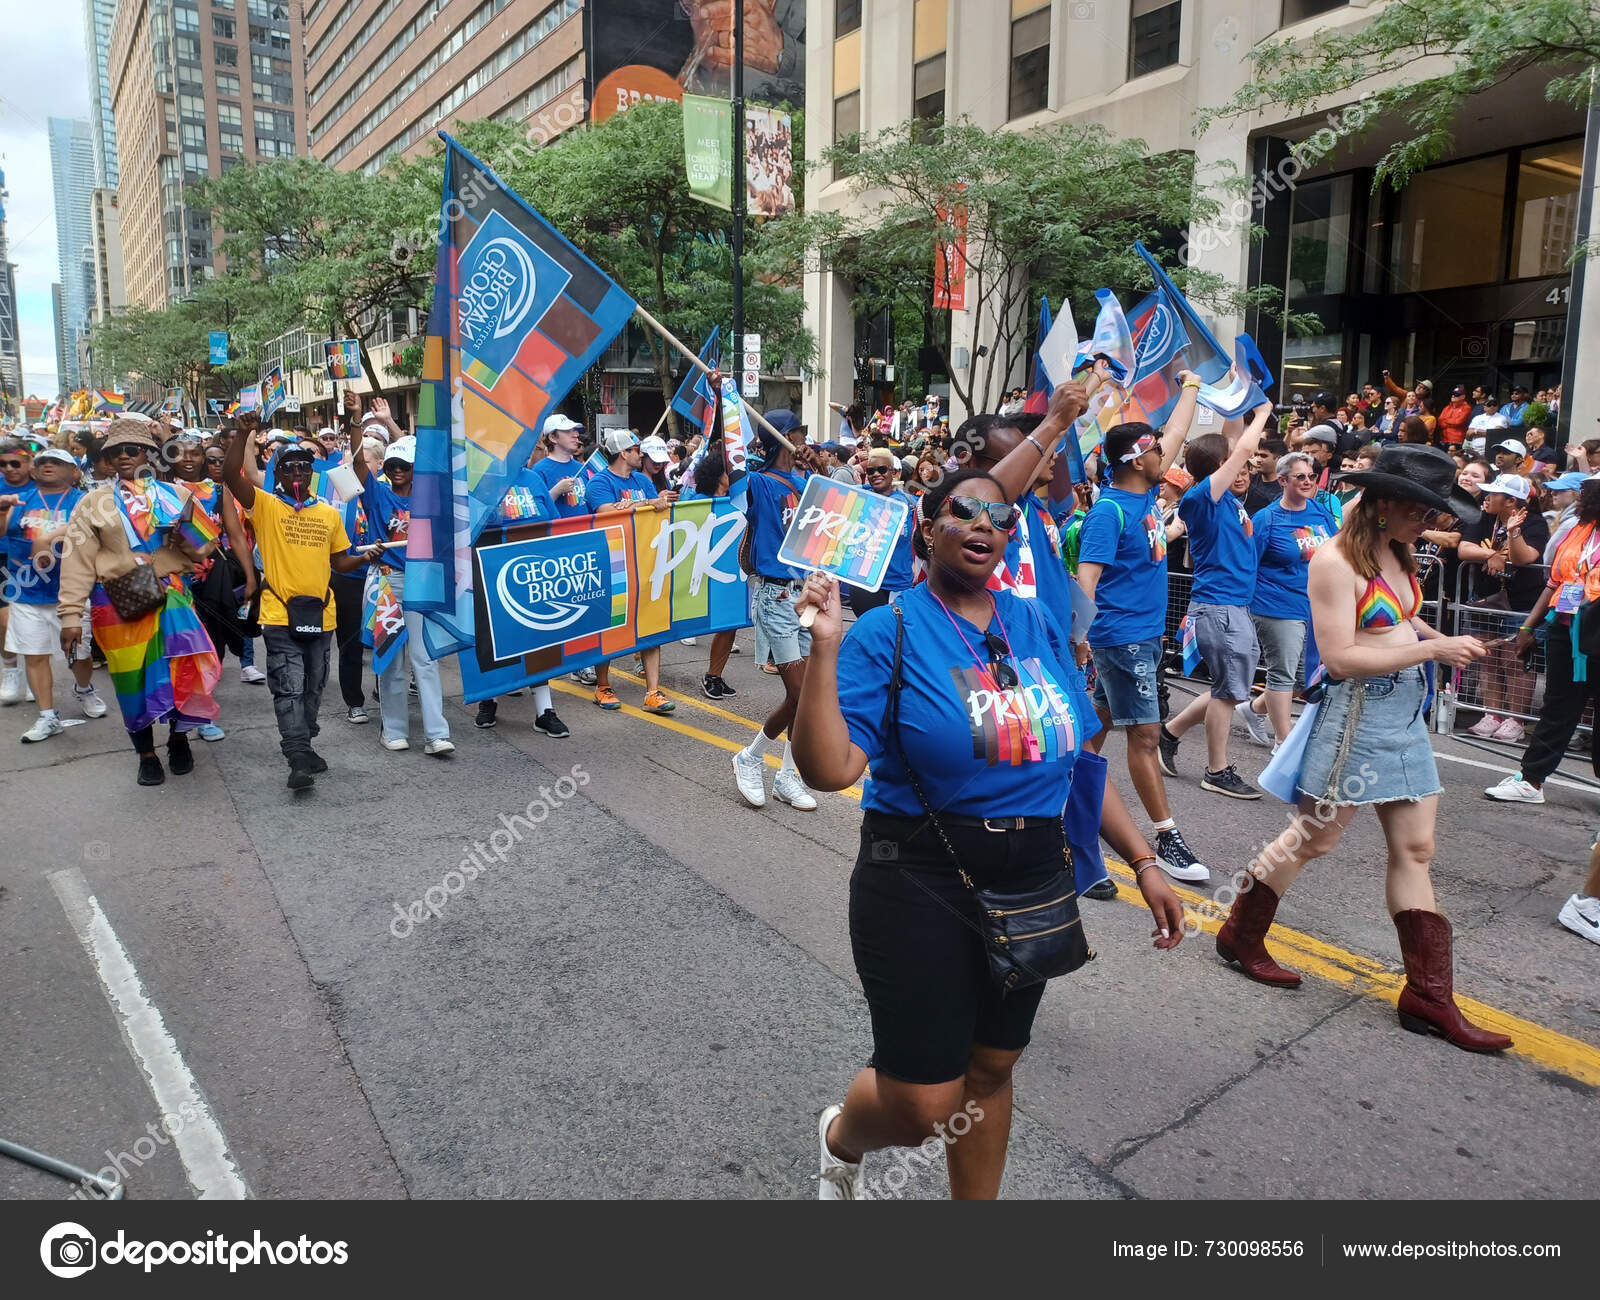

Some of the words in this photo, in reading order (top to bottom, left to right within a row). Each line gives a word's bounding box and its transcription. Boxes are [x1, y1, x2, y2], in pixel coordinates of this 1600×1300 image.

[697, 138, 720, 148] MEET
[328, 352, 358, 367] PRIDE
[287, 402, 299, 410] 40
[798, 504, 891, 552] PRIDE
[512, 551, 598, 585] GEORGE
[528, 570, 602, 604] BROWN
[571, 589, 606, 603] COLLEGE
[296, 625, 322, 633] adidas
[967, 684, 1069, 727] PRIDE
[1043, 714, 1075, 727] @GBC
